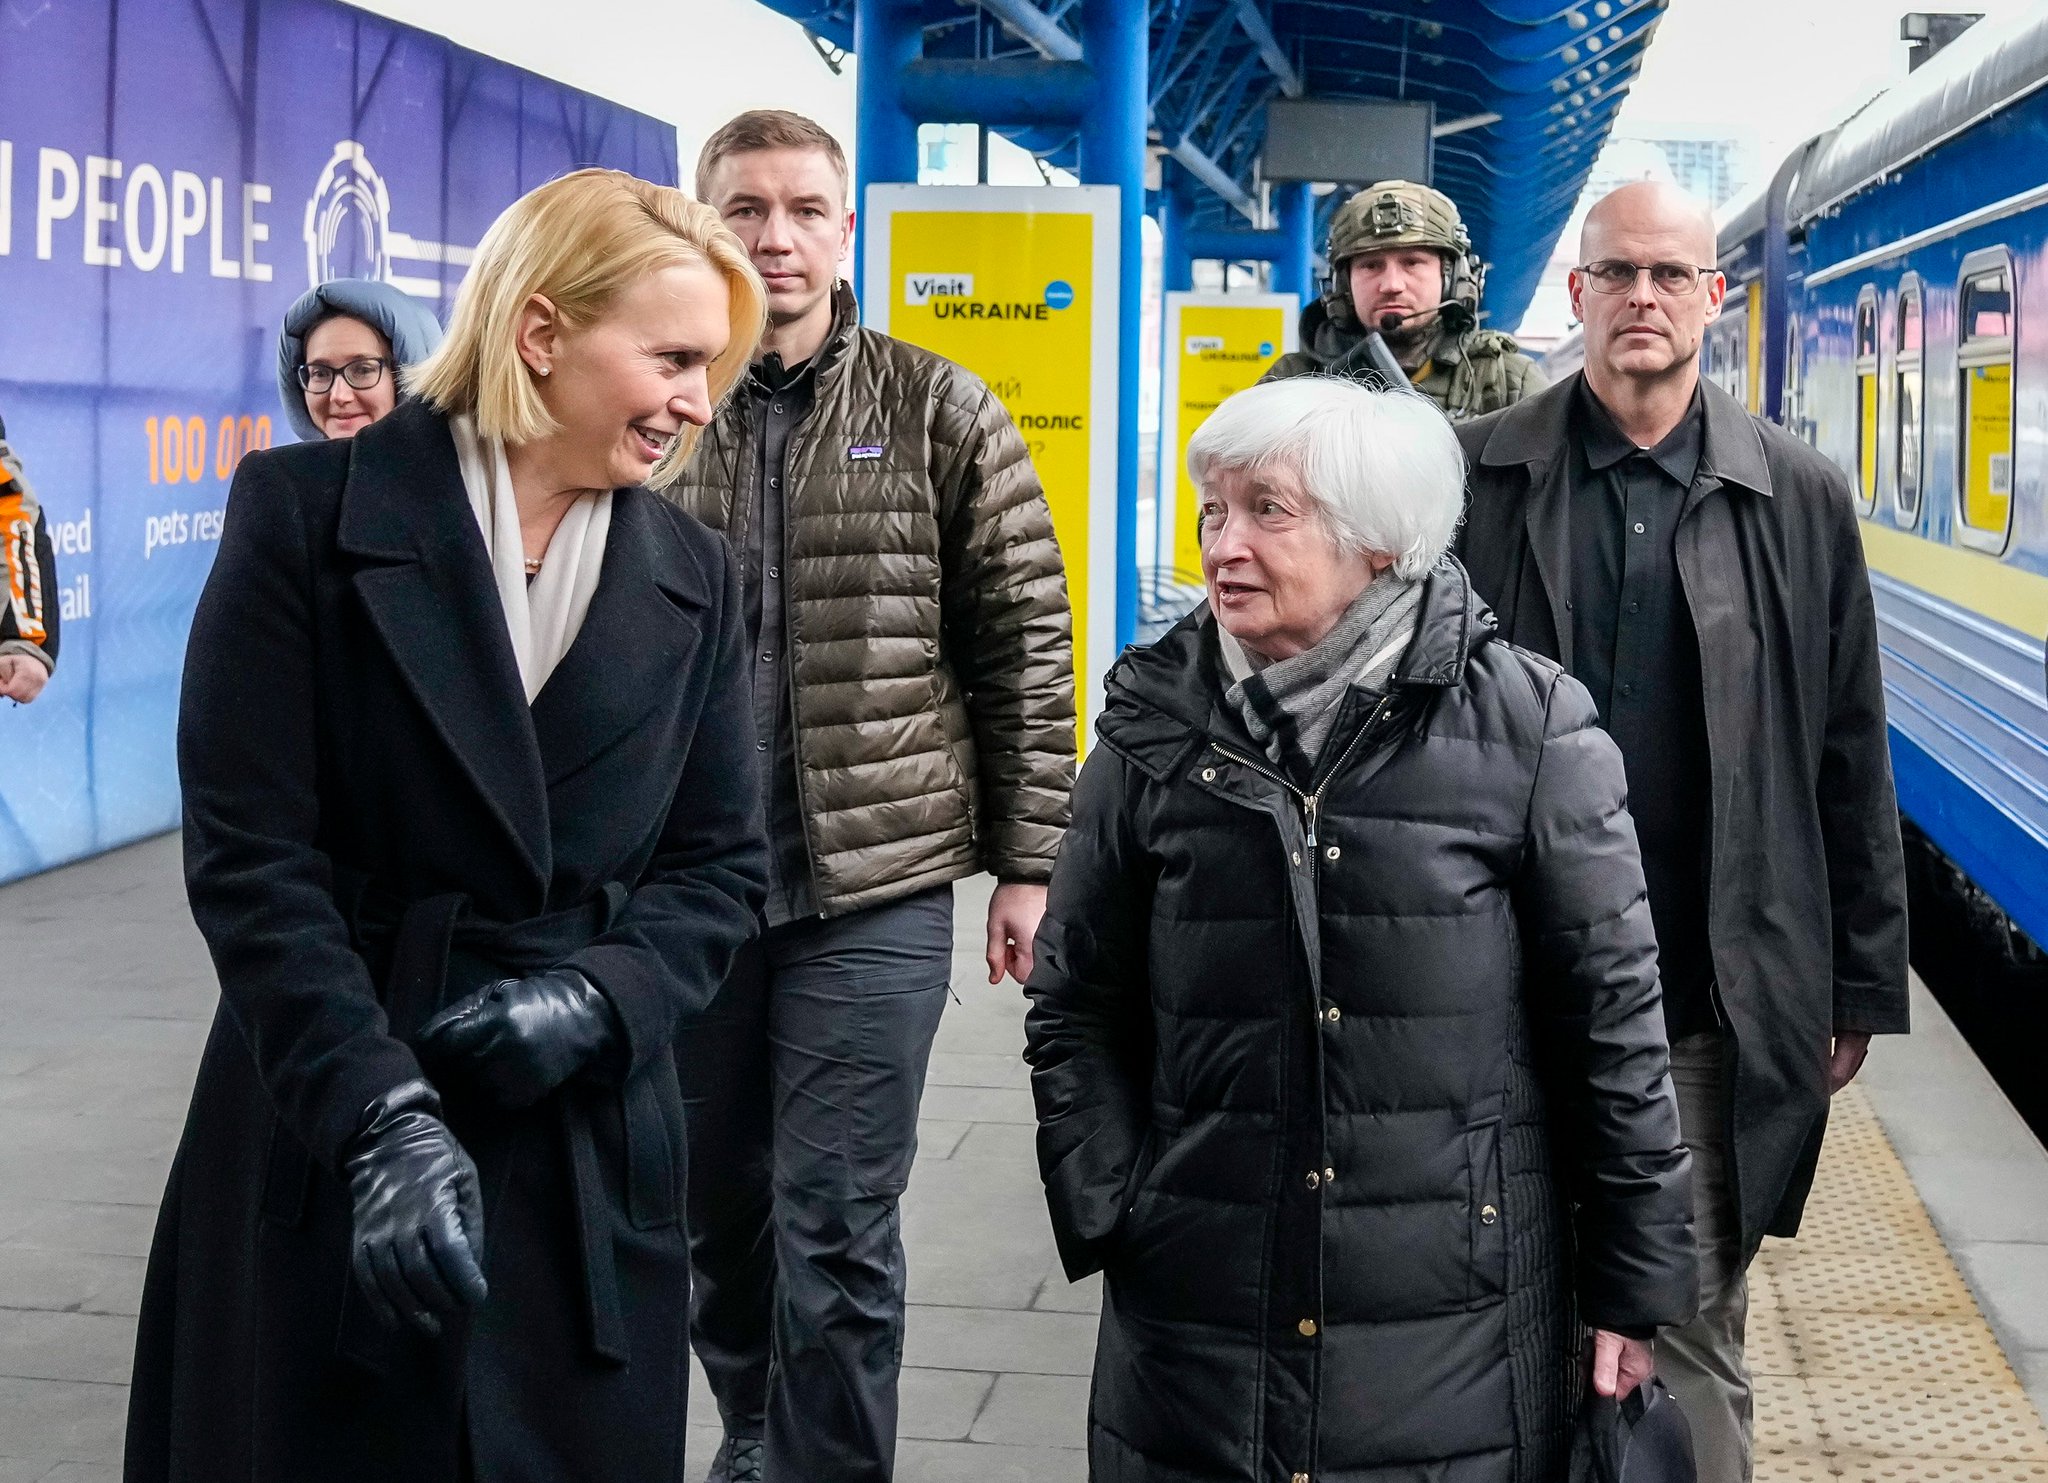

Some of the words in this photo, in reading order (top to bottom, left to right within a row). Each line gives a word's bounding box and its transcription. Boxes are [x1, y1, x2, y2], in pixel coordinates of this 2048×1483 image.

[37, 146, 272, 282] PEOPLE
[914, 279, 965, 296] Visit
[935, 302, 1049, 320] UKRAINE
[145, 415, 206, 485] 100
[144, 510, 189, 560] pets
[192, 509, 226, 541] res
[59, 573, 91, 621] ail
